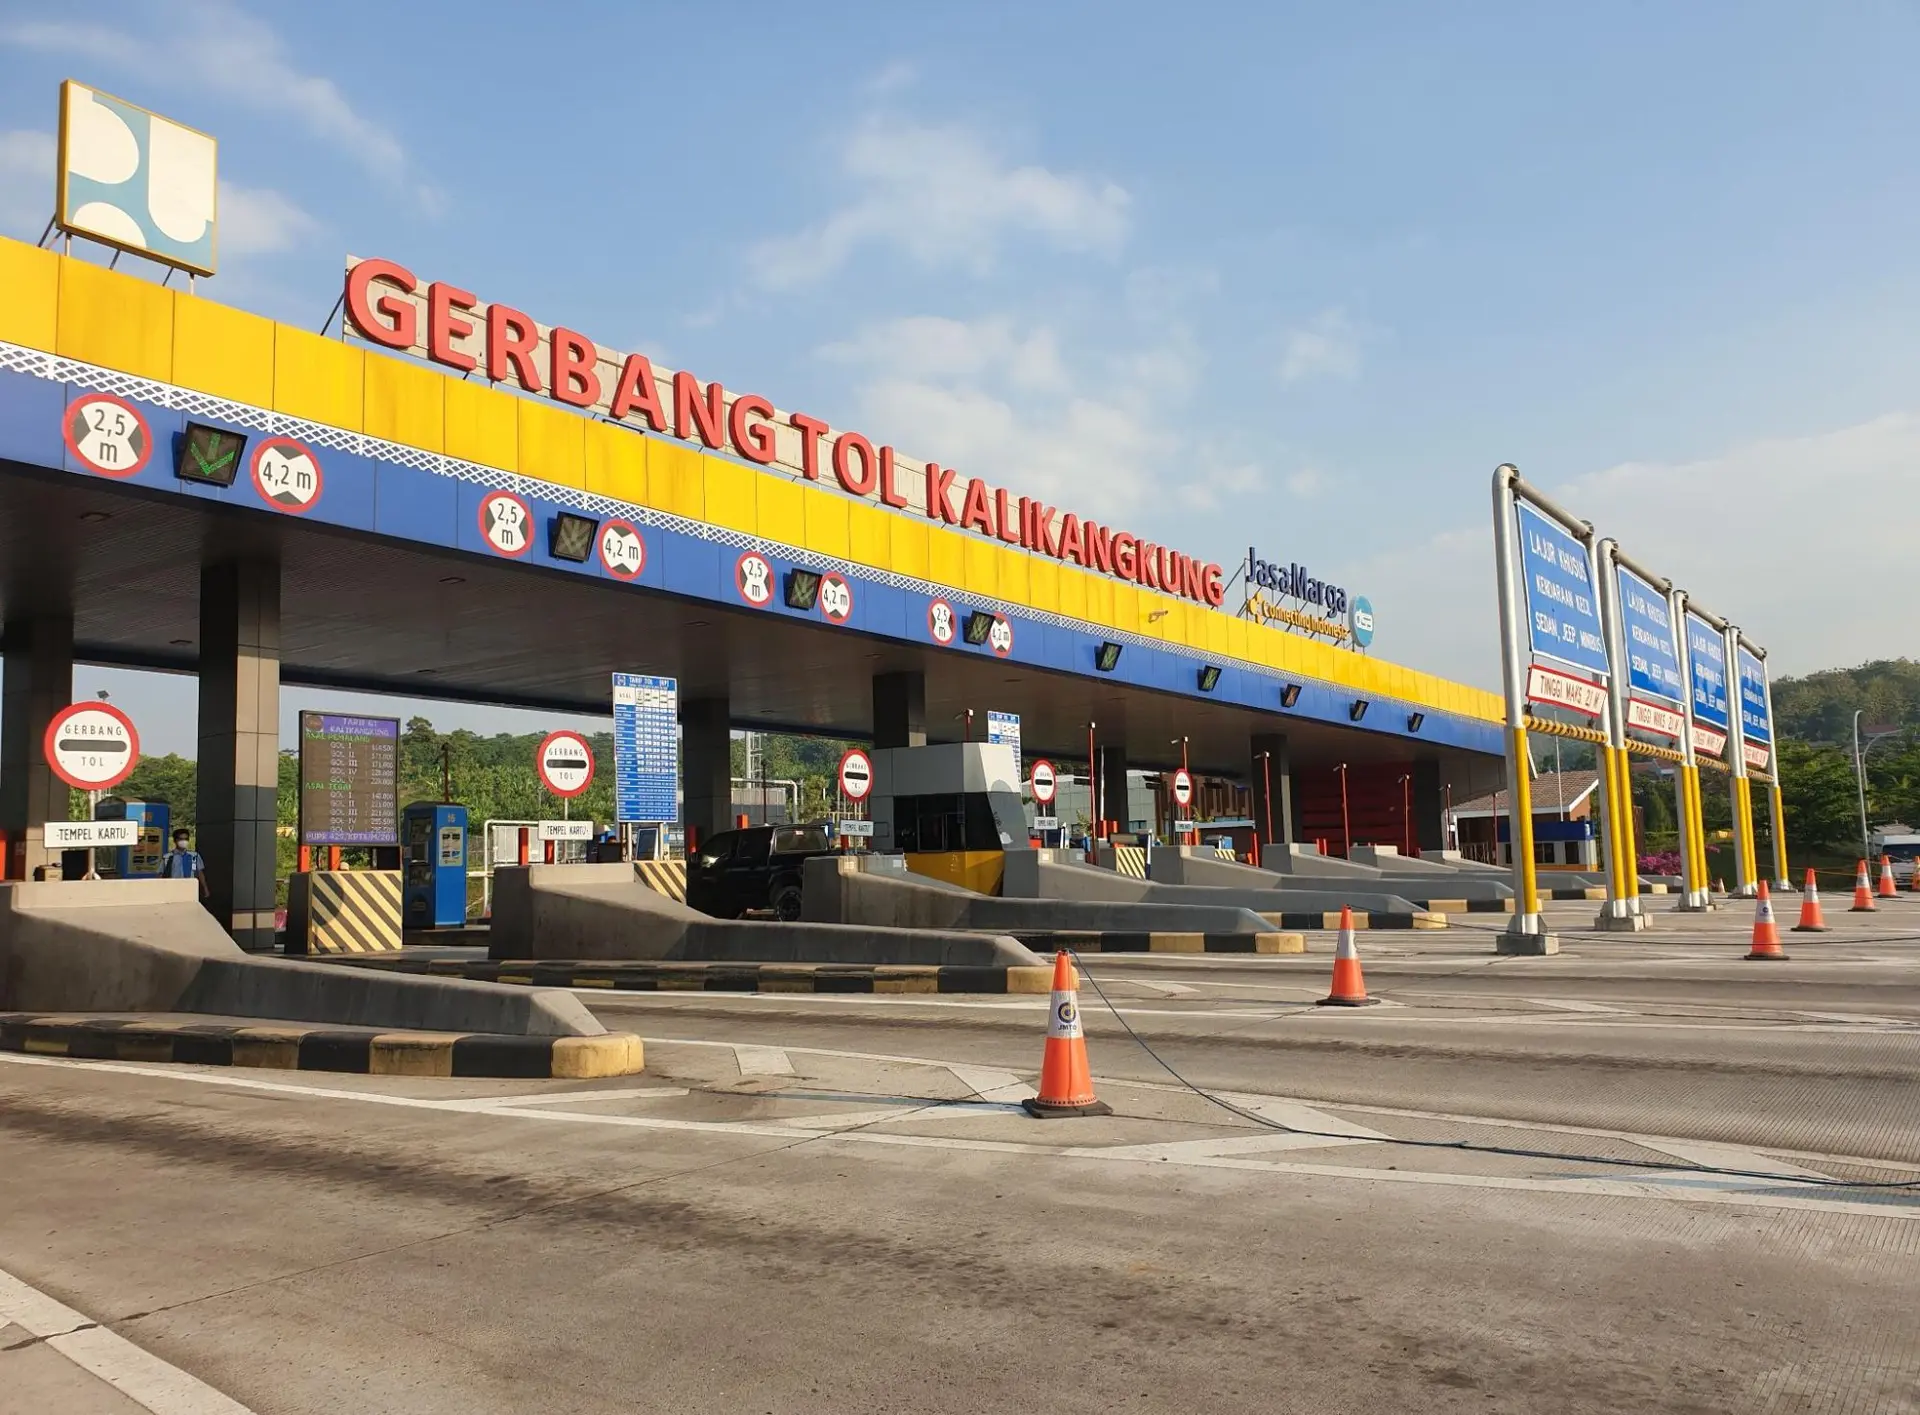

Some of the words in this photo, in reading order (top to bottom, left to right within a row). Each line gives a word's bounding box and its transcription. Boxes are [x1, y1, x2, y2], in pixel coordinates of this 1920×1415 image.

[94, 408, 126, 438] 2,5
[345, 257, 776, 464] GERBANG
[790, 412, 907, 508] TOL
[926, 462, 1224, 606] KALIKANGKUNG
[99, 441, 118, 463] m
[262, 461, 290, 486] 4,2
[296, 470, 312, 490] m
[497, 503, 517, 526] 2,5
[501, 529, 514, 546] m
[1529, 529, 1556, 565] LAJUR
[605, 537, 623, 558] 4,2
[628, 543, 639, 561] m
[748, 560, 763, 579] 2,5
[751, 584, 761, 597] m
[1246, 546, 1348, 619] JasaMarga
[823, 588, 837, 606] 4,2
[840, 593, 848, 607] m
[1540, 675, 1563, 698] TINGGI
[64, 724, 123, 736] GERBANG
[81, 756, 104, 767] TOL
[549, 747, 583, 757] GERBANG
[559, 771, 574, 780] TOL
[59, 828, 93, 841] TEMPEL
[98, 827, 127, 840] KARTU
[547, 825, 567, 836] TEMPEL
